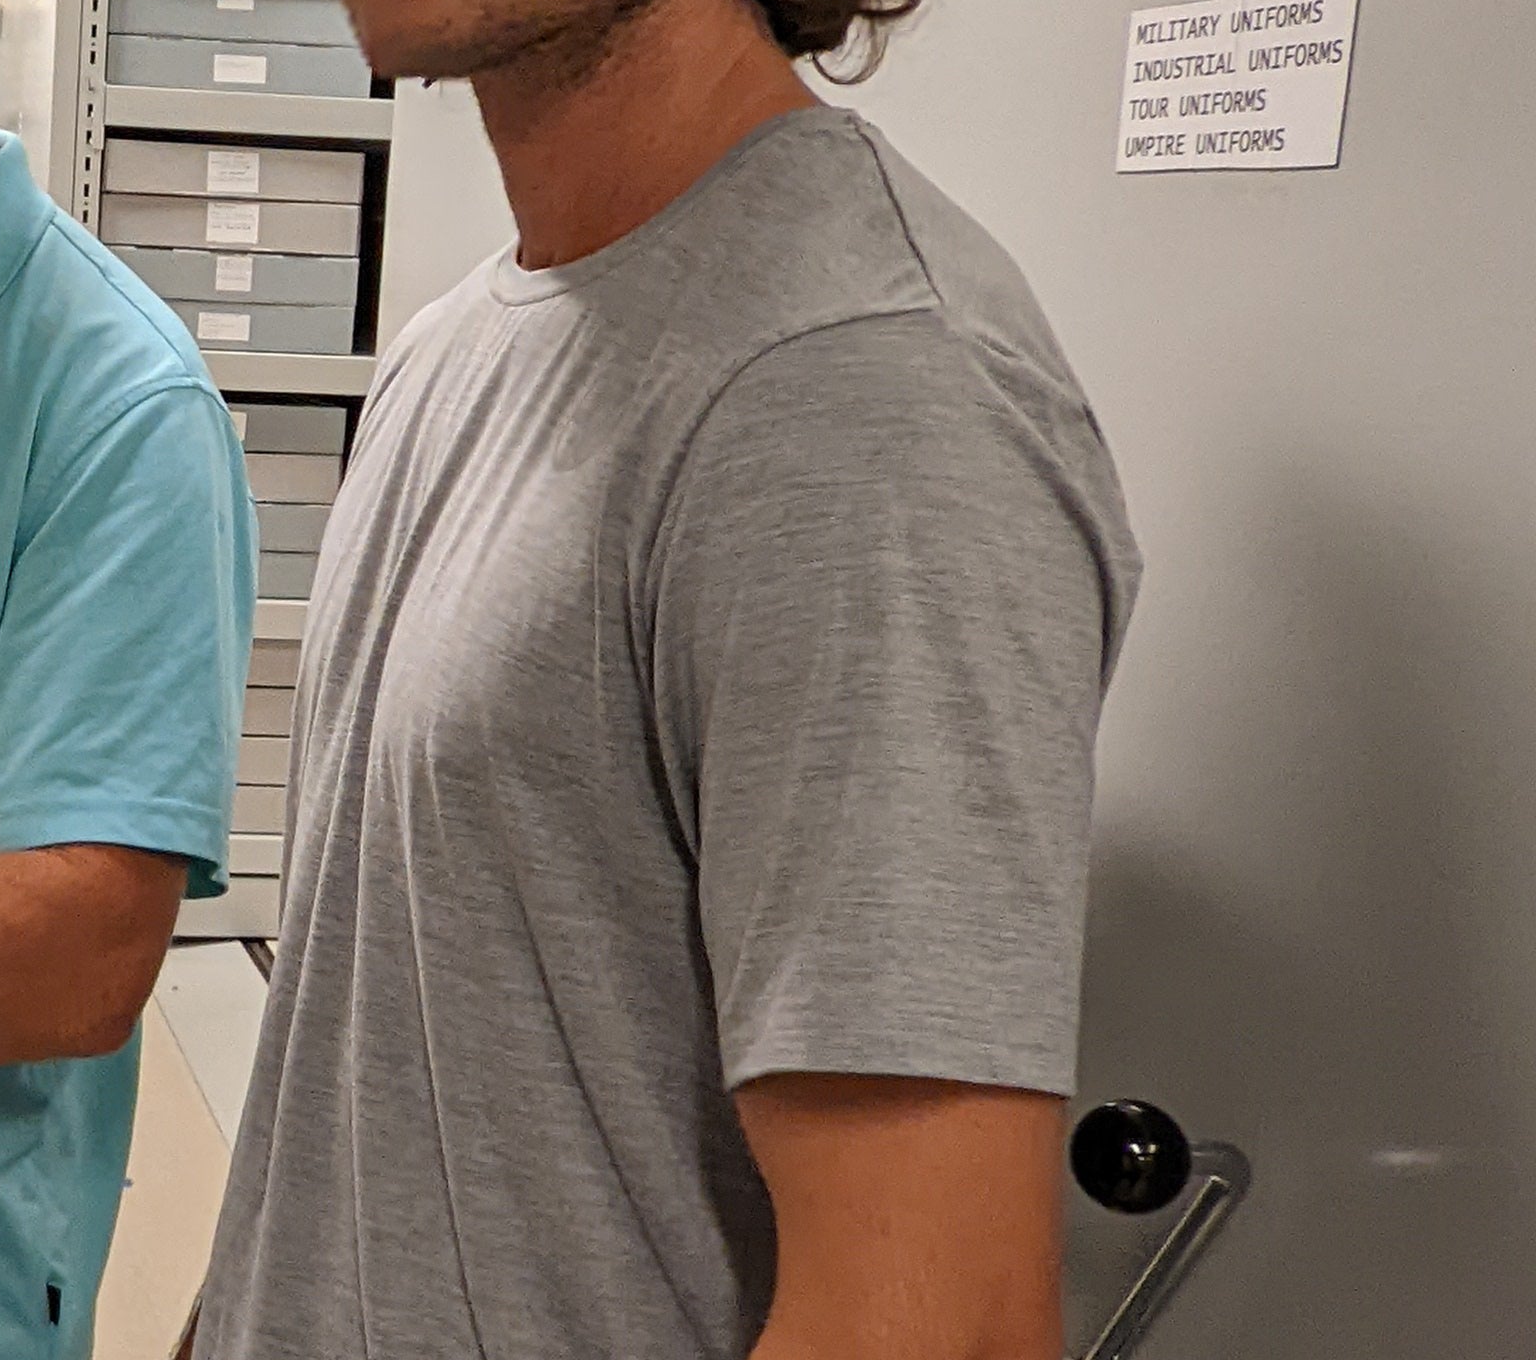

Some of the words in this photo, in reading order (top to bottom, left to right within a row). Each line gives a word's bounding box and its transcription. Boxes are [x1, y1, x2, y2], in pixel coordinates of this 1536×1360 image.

[1136, 14, 1222, 44] MILITARY
[1230, 0, 1324, 33] UNIFORMS
[1132, 52, 1236, 83] INDUSTRIAL
[1248, 39, 1344, 72] UNIFORMS
[1129, 97, 1169, 121] TOUR
[1179, 88, 1267, 117] UNIFORMS
[1124, 134, 1187, 158] UMPIRE
[1195, 128, 1286, 155] UNIFORMS
